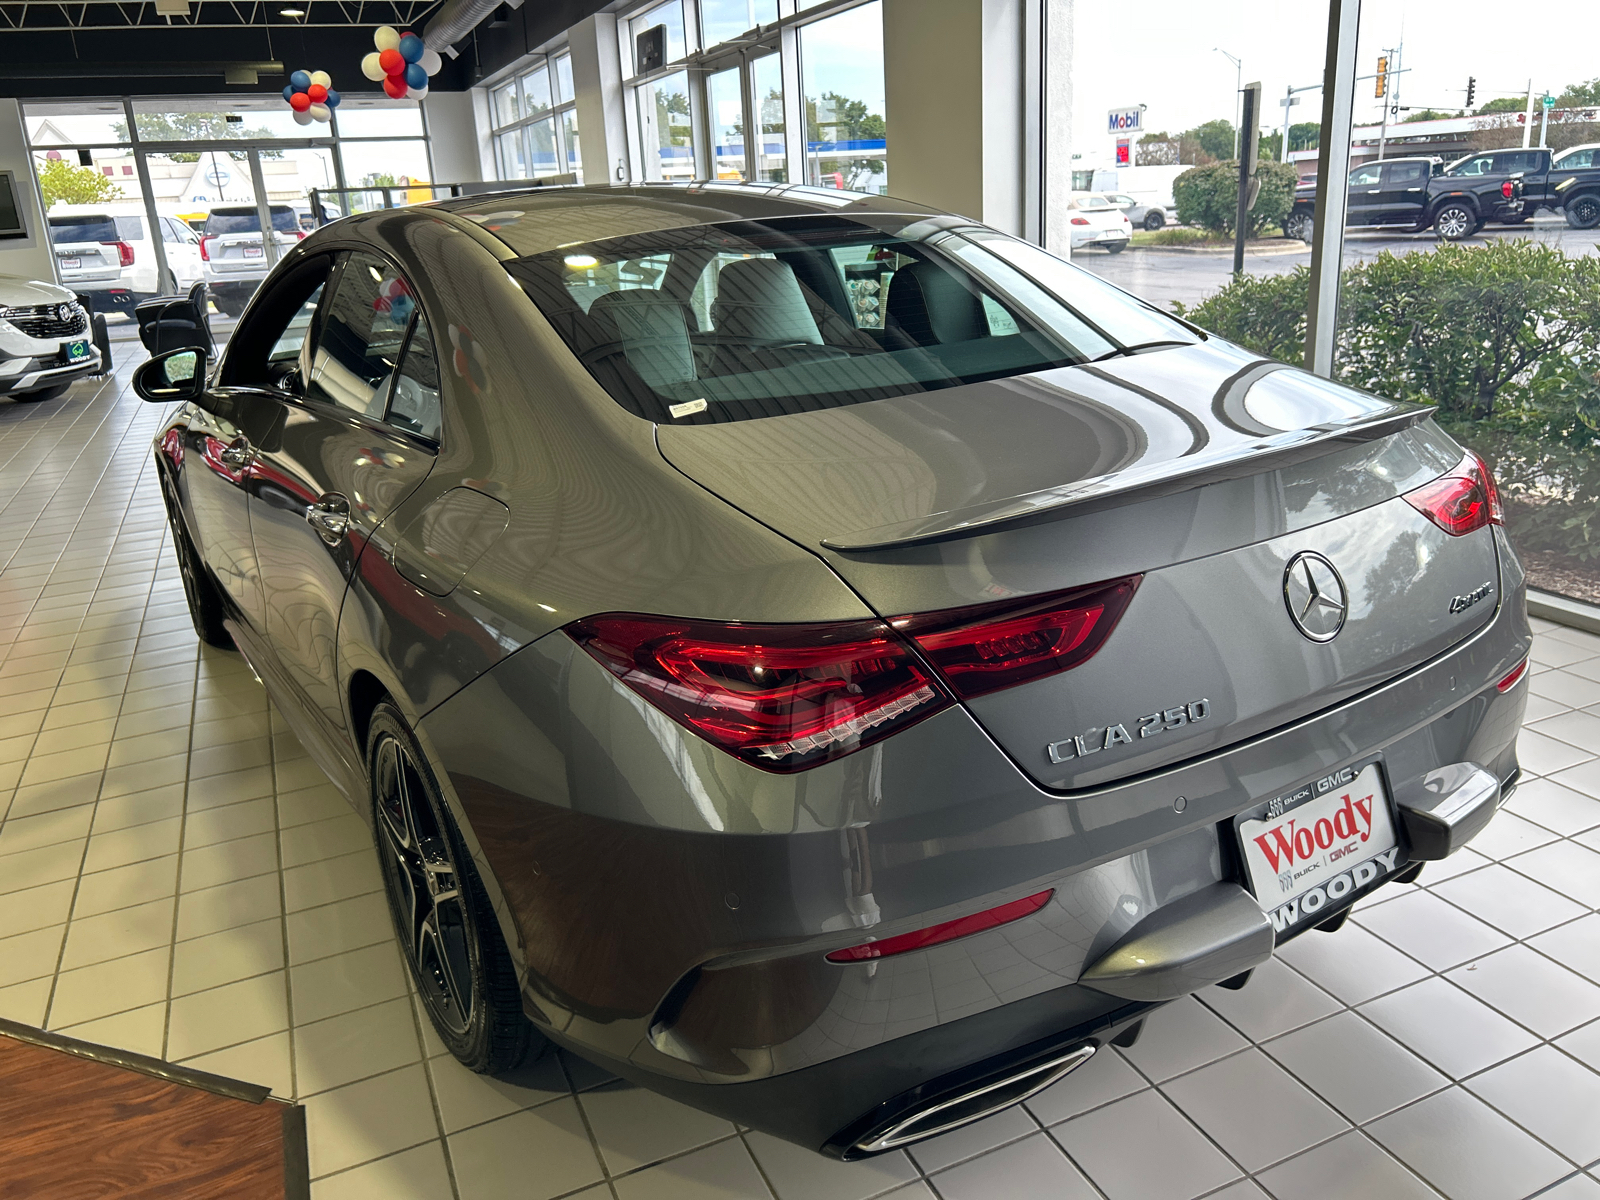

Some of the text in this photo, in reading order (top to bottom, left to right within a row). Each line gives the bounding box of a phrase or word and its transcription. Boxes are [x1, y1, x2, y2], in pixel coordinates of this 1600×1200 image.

[1109, 110, 1139, 129] Mobil
[1047, 697, 1212, 764] CLA 250
[1283, 767, 1353, 806] BUICK GMC
[1253, 794, 1374, 875] Woody
[1294, 841, 1359, 880] BUICK GMC
[1269, 848, 1399, 933] WOODY
